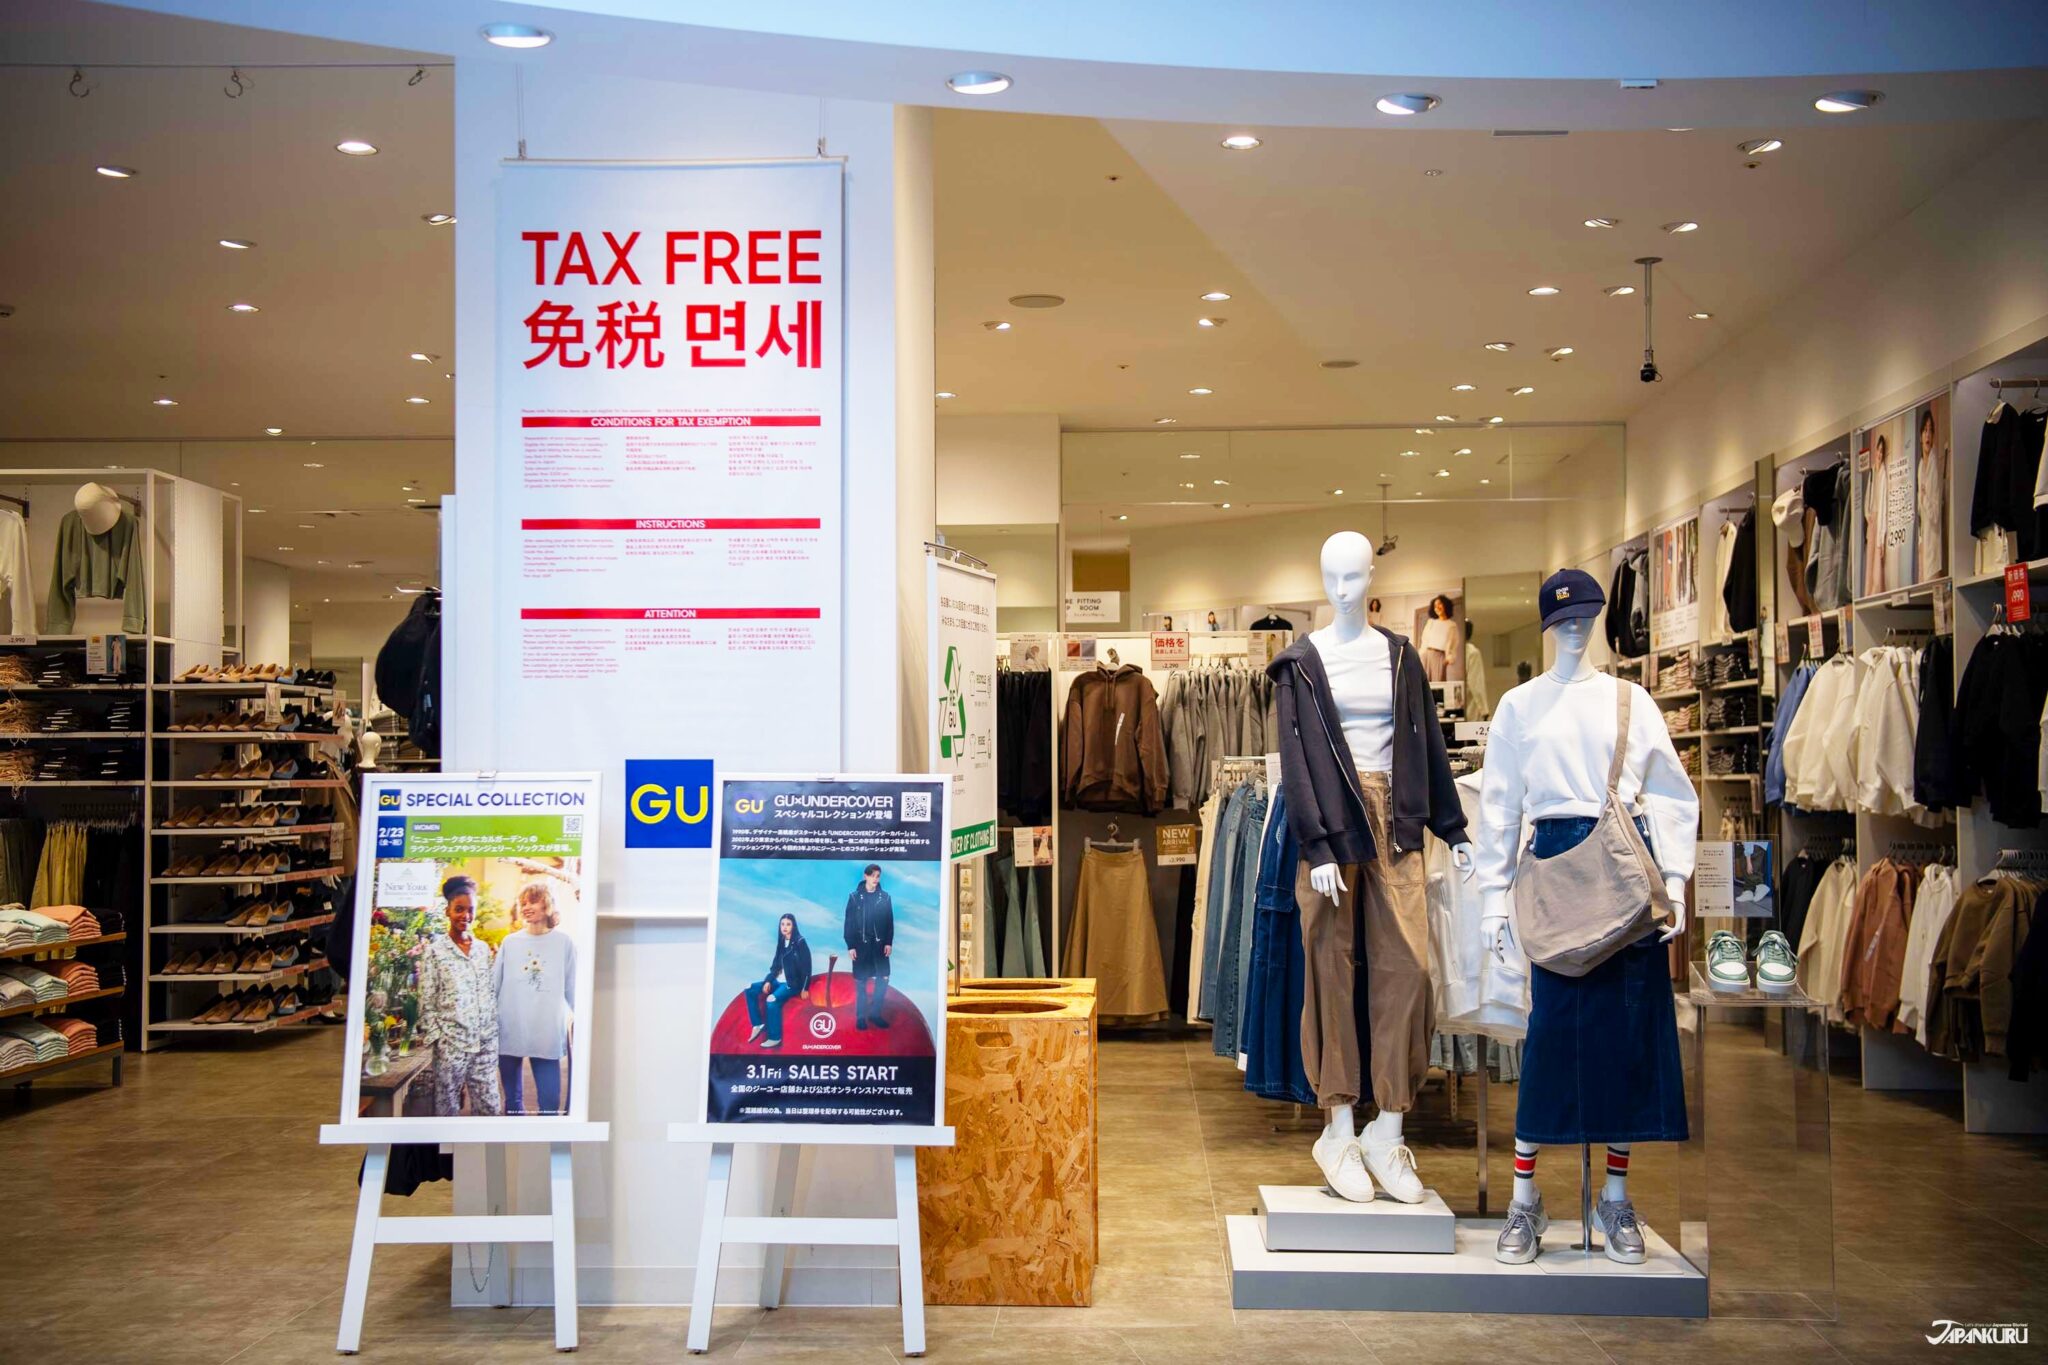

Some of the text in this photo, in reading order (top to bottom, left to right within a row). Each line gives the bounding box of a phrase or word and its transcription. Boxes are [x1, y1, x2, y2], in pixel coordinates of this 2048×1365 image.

[522, 230, 822, 286] TAX FREE
[523, 300, 822, 369] 免税 면세
[590, 417, 751, 426] CONDITIONS FOR TAX EXEMPTION
[636, 520, 706, 528] INSTRUCTIONS
[644, 609, 696, 618] ATTENTION
[1154, 638, 1184, 648] 価格を
[948, 712, 956, 728] GU
[379, 792, 585, 807] GU SPECIAL COLLECTION
[630, 783, 709, 824] GU
[774, 795, 893, 808] GU×UNDERCOVER
[735, 799, 764, 814] GU
[774, 810, 892, 820] スペシャルコレクションが登場
[379, 827, 405, 838] 2/23
[1162, 828, 1190, 838] NEW
[747, 1065, 899, 1080] 3.1Fri SALES START
